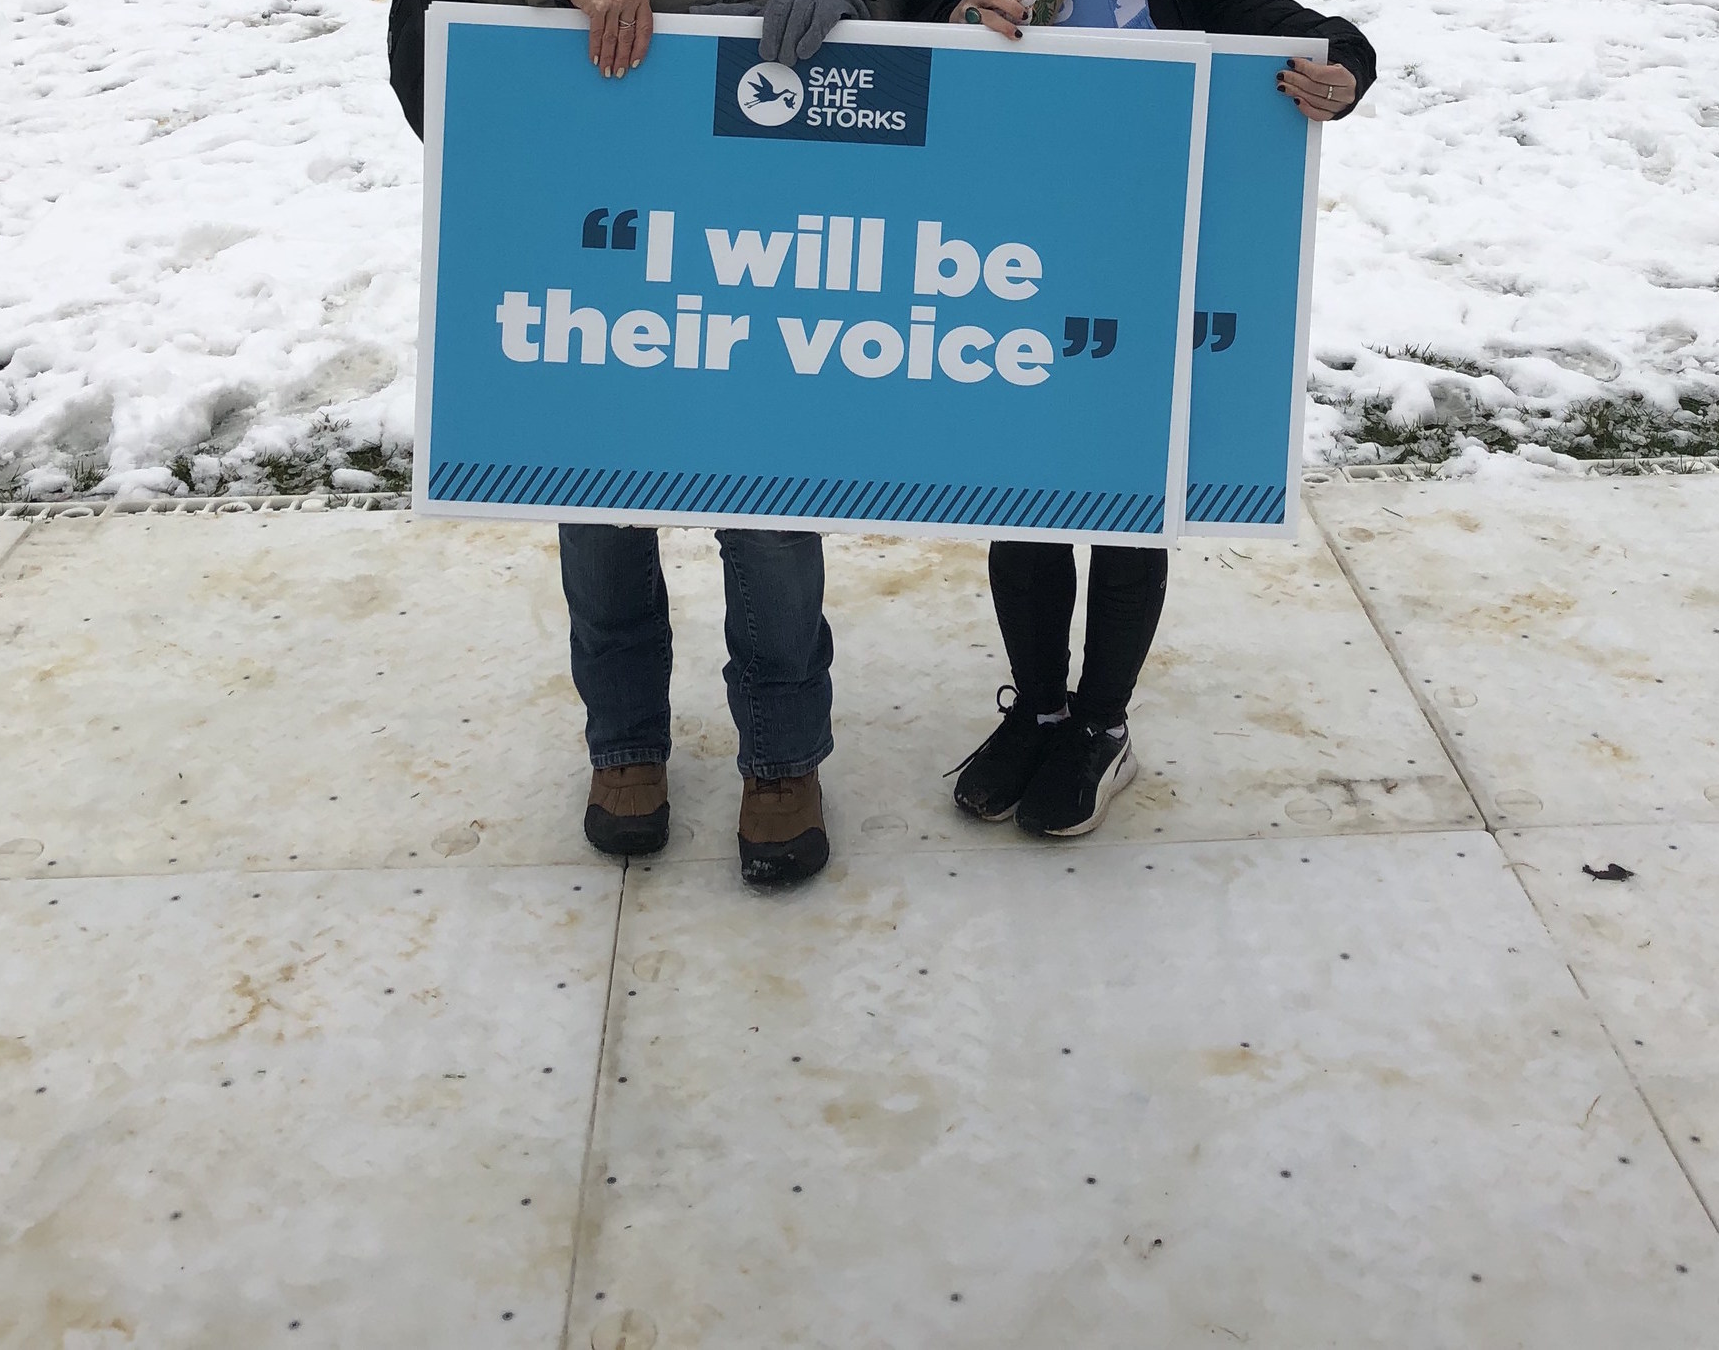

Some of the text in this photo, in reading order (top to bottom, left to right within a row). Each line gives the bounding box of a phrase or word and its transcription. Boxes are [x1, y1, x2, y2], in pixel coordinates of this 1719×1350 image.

[808, 66, 875, 89] SAVE
[807, 86, 858, 108] THE
[806, 106, 907, 131] STORKS
[704, 214, 886, 293] will
[913, 220, 1043, 301] be
[495, 288, 751, 371] their
